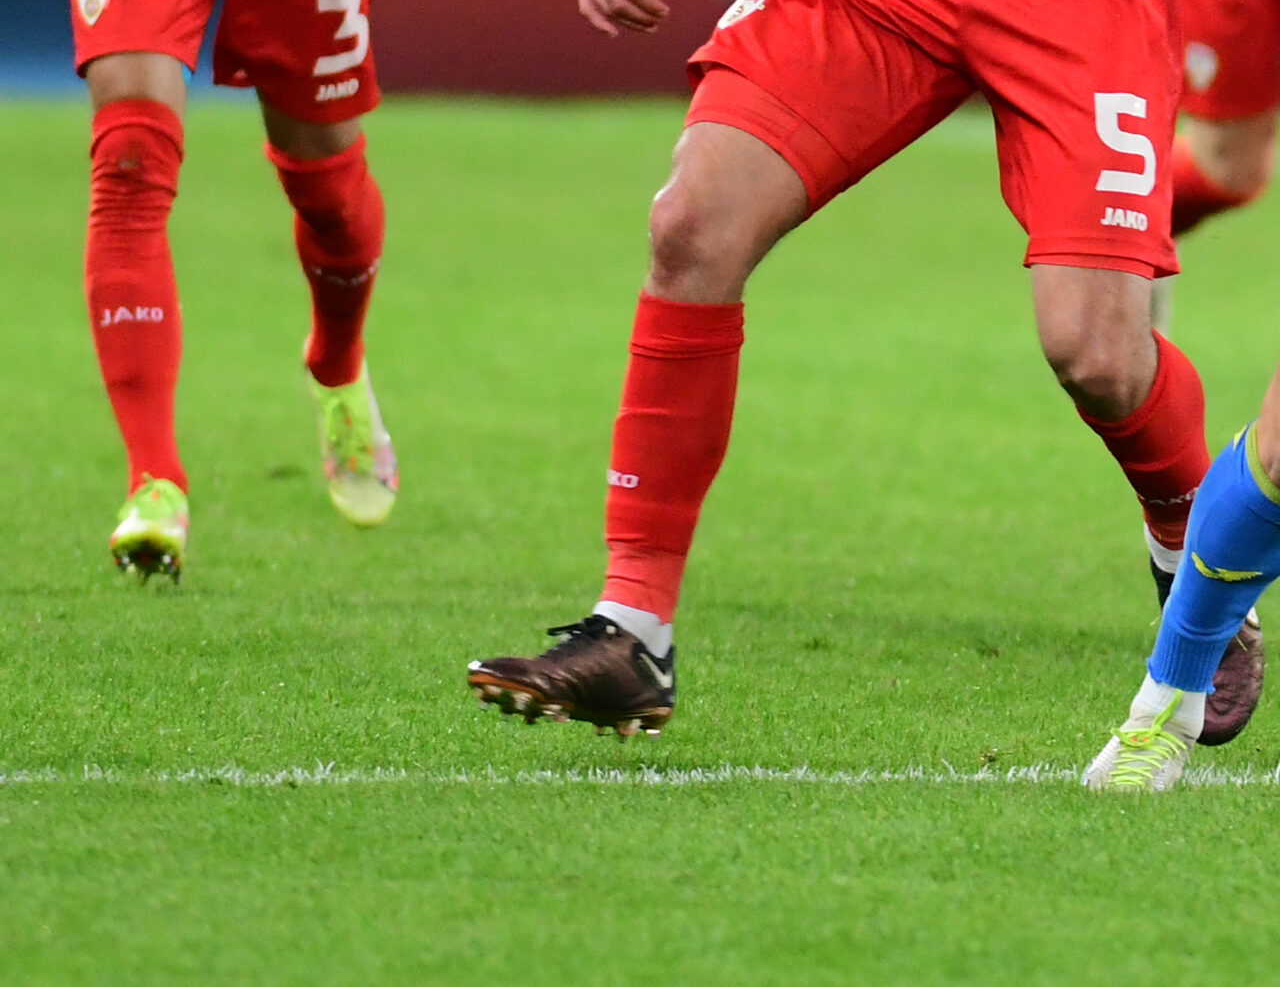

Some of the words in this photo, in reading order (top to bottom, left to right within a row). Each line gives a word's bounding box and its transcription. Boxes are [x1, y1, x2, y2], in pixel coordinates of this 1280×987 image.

[314, 77, 360, 102] JAKO
[1093, 92, 1157, 196] 5
[1100, 206, 1149, 232] JAKO
[100, 306, 164, 327] JAKO
